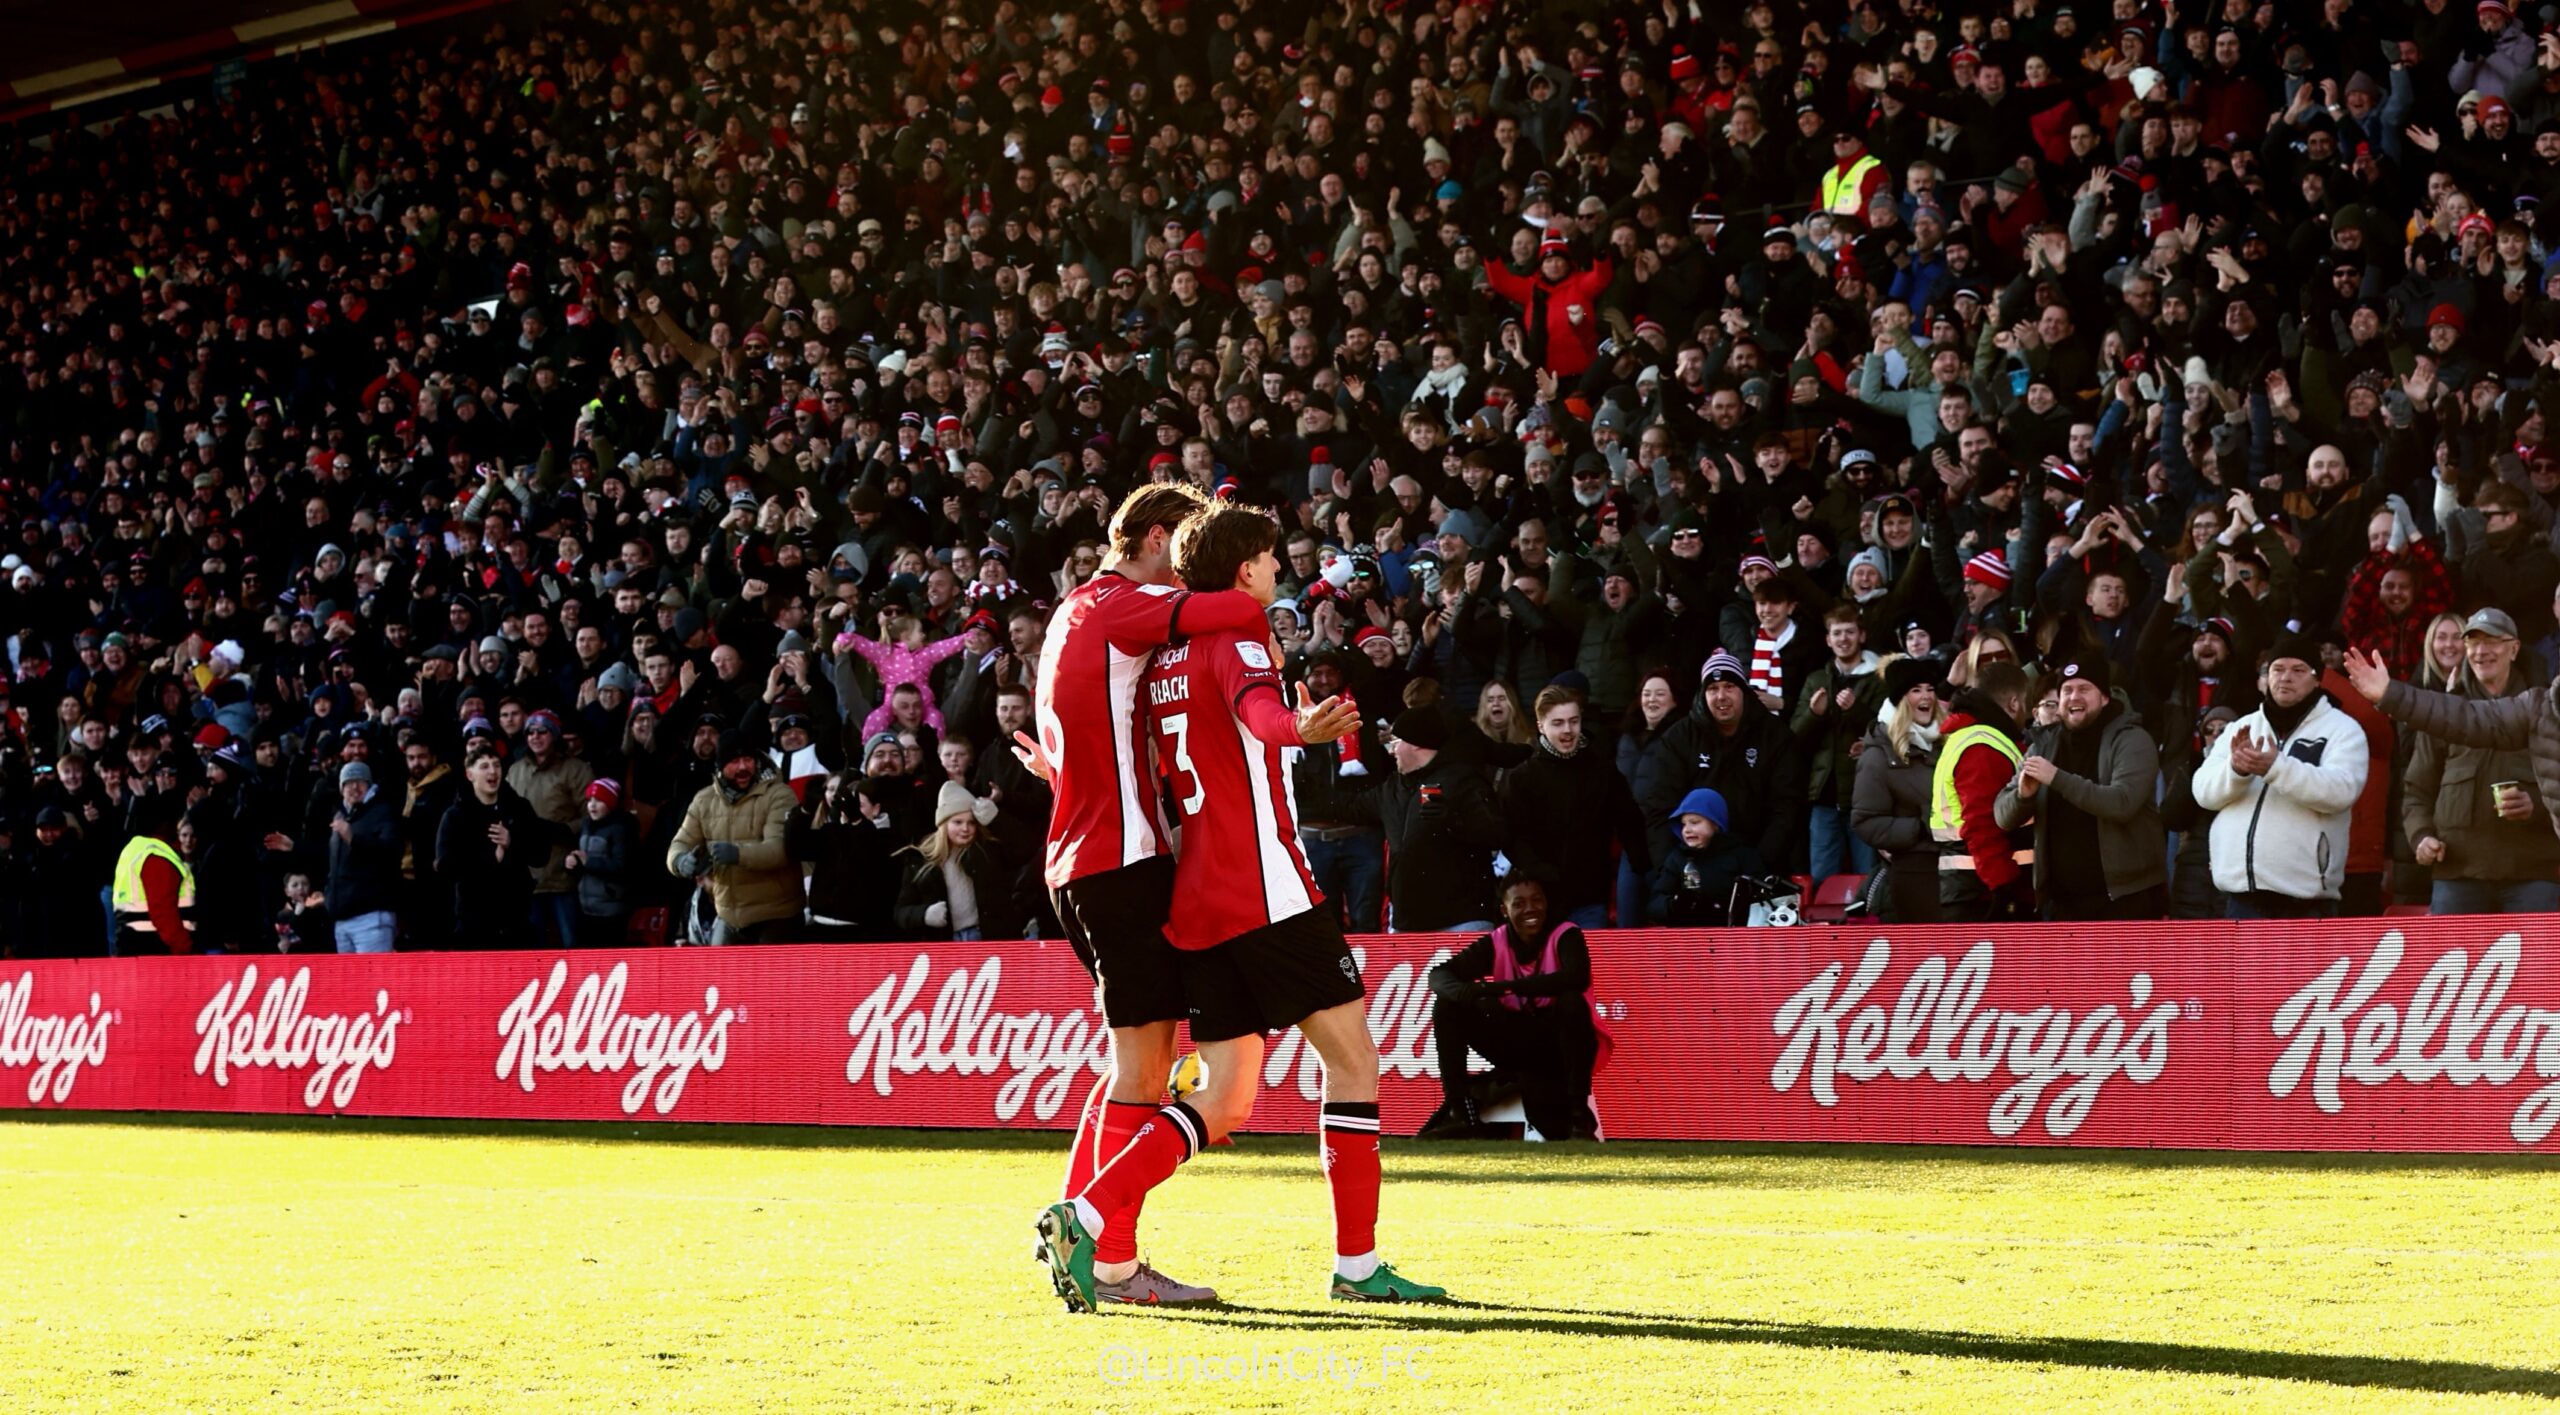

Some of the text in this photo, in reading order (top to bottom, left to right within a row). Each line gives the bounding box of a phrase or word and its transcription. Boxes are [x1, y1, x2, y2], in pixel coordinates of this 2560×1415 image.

[1160, 711, 1206, 816] 3
[193, 963, 402, 1109] Kellogg's
[495, 958, 735, 1115] Kellogg's
[1770, 938, 2180, 1137] Kellogg's
